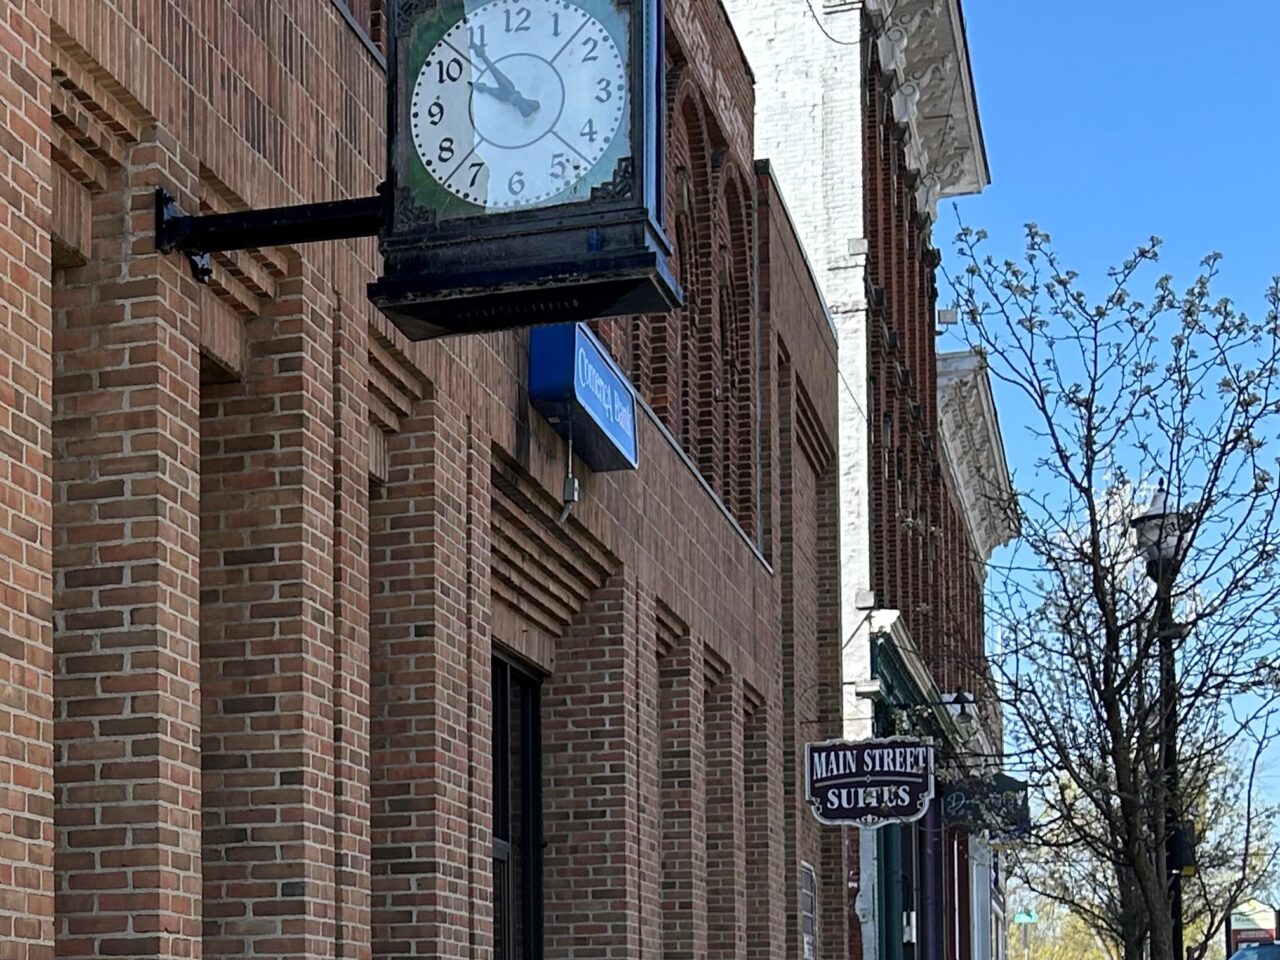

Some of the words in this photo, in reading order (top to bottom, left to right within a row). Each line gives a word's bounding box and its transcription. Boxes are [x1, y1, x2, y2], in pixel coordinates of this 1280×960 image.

[504, 7, 531, 33] 12
[551, 12, 561, 37] 1
[466, 24, 488, 49] 11
[581, 36, 599, 63] 2
[436, 57, 463, 84] 10
[594, 77, 612, 104] 3
[427, 101, 444, 126] 9
[580, 118, 598, 143] 4
[435, 137, 454, 163] 8
[468, 162, 485, 188] 7
[549, 152, 567, 179] 5
[508, 170, 525, 195] 6
[812, 749, 858, 780] MAIN
[863, 747, 927, 774] STREET
[827, 784, 910, 809] SUITES
